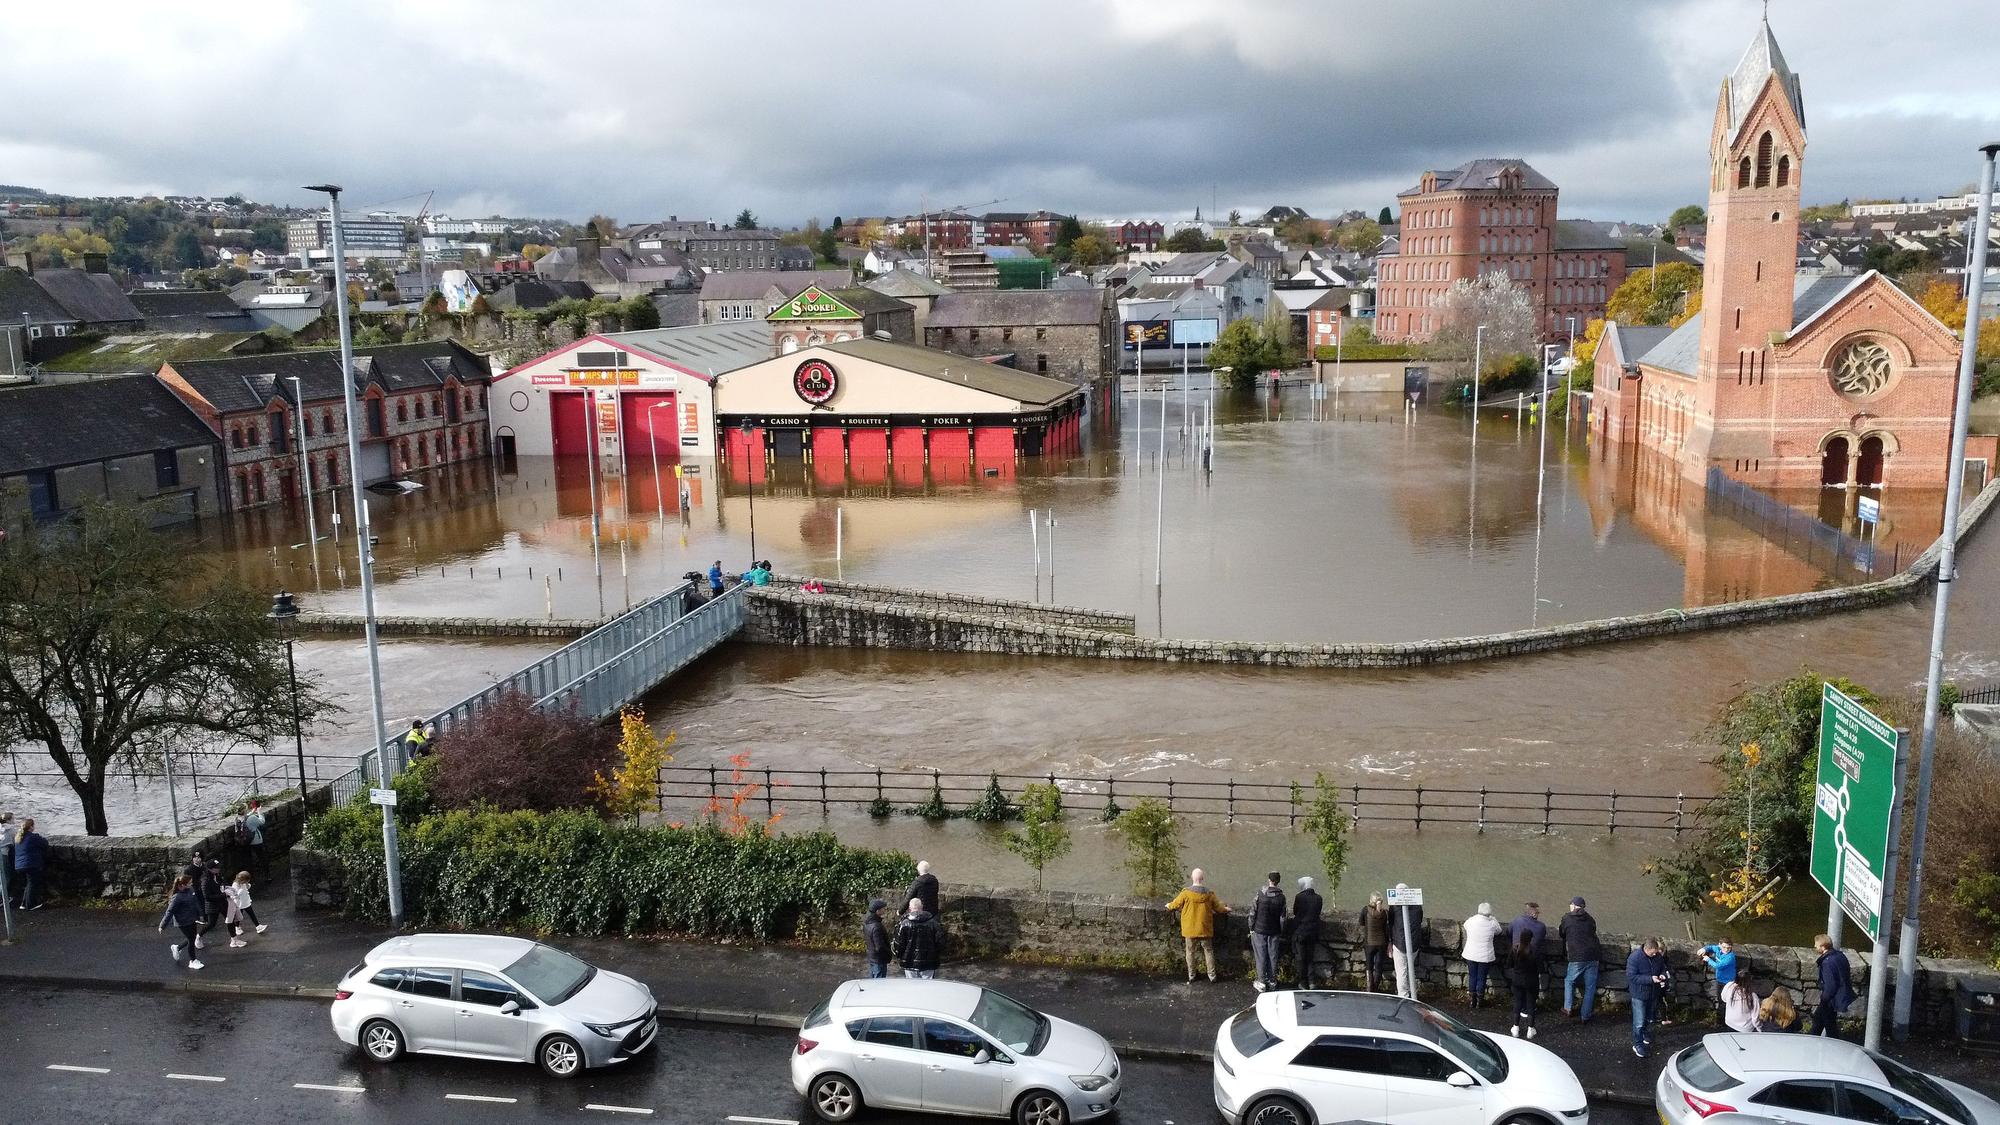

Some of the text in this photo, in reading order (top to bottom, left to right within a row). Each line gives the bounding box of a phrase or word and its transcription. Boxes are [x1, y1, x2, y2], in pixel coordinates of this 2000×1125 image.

[791, 301, 837, 316] SNOOKER
[570, 370, 613, 380] THOMPSON
[810, 368, 821, 383] Q
[933, 417, 960, 425] POKER
[1020, 415, 1048, 423] SNOOKER
[1829, 690, 1890, 739] SANDY STREET ROUNDABOUT
